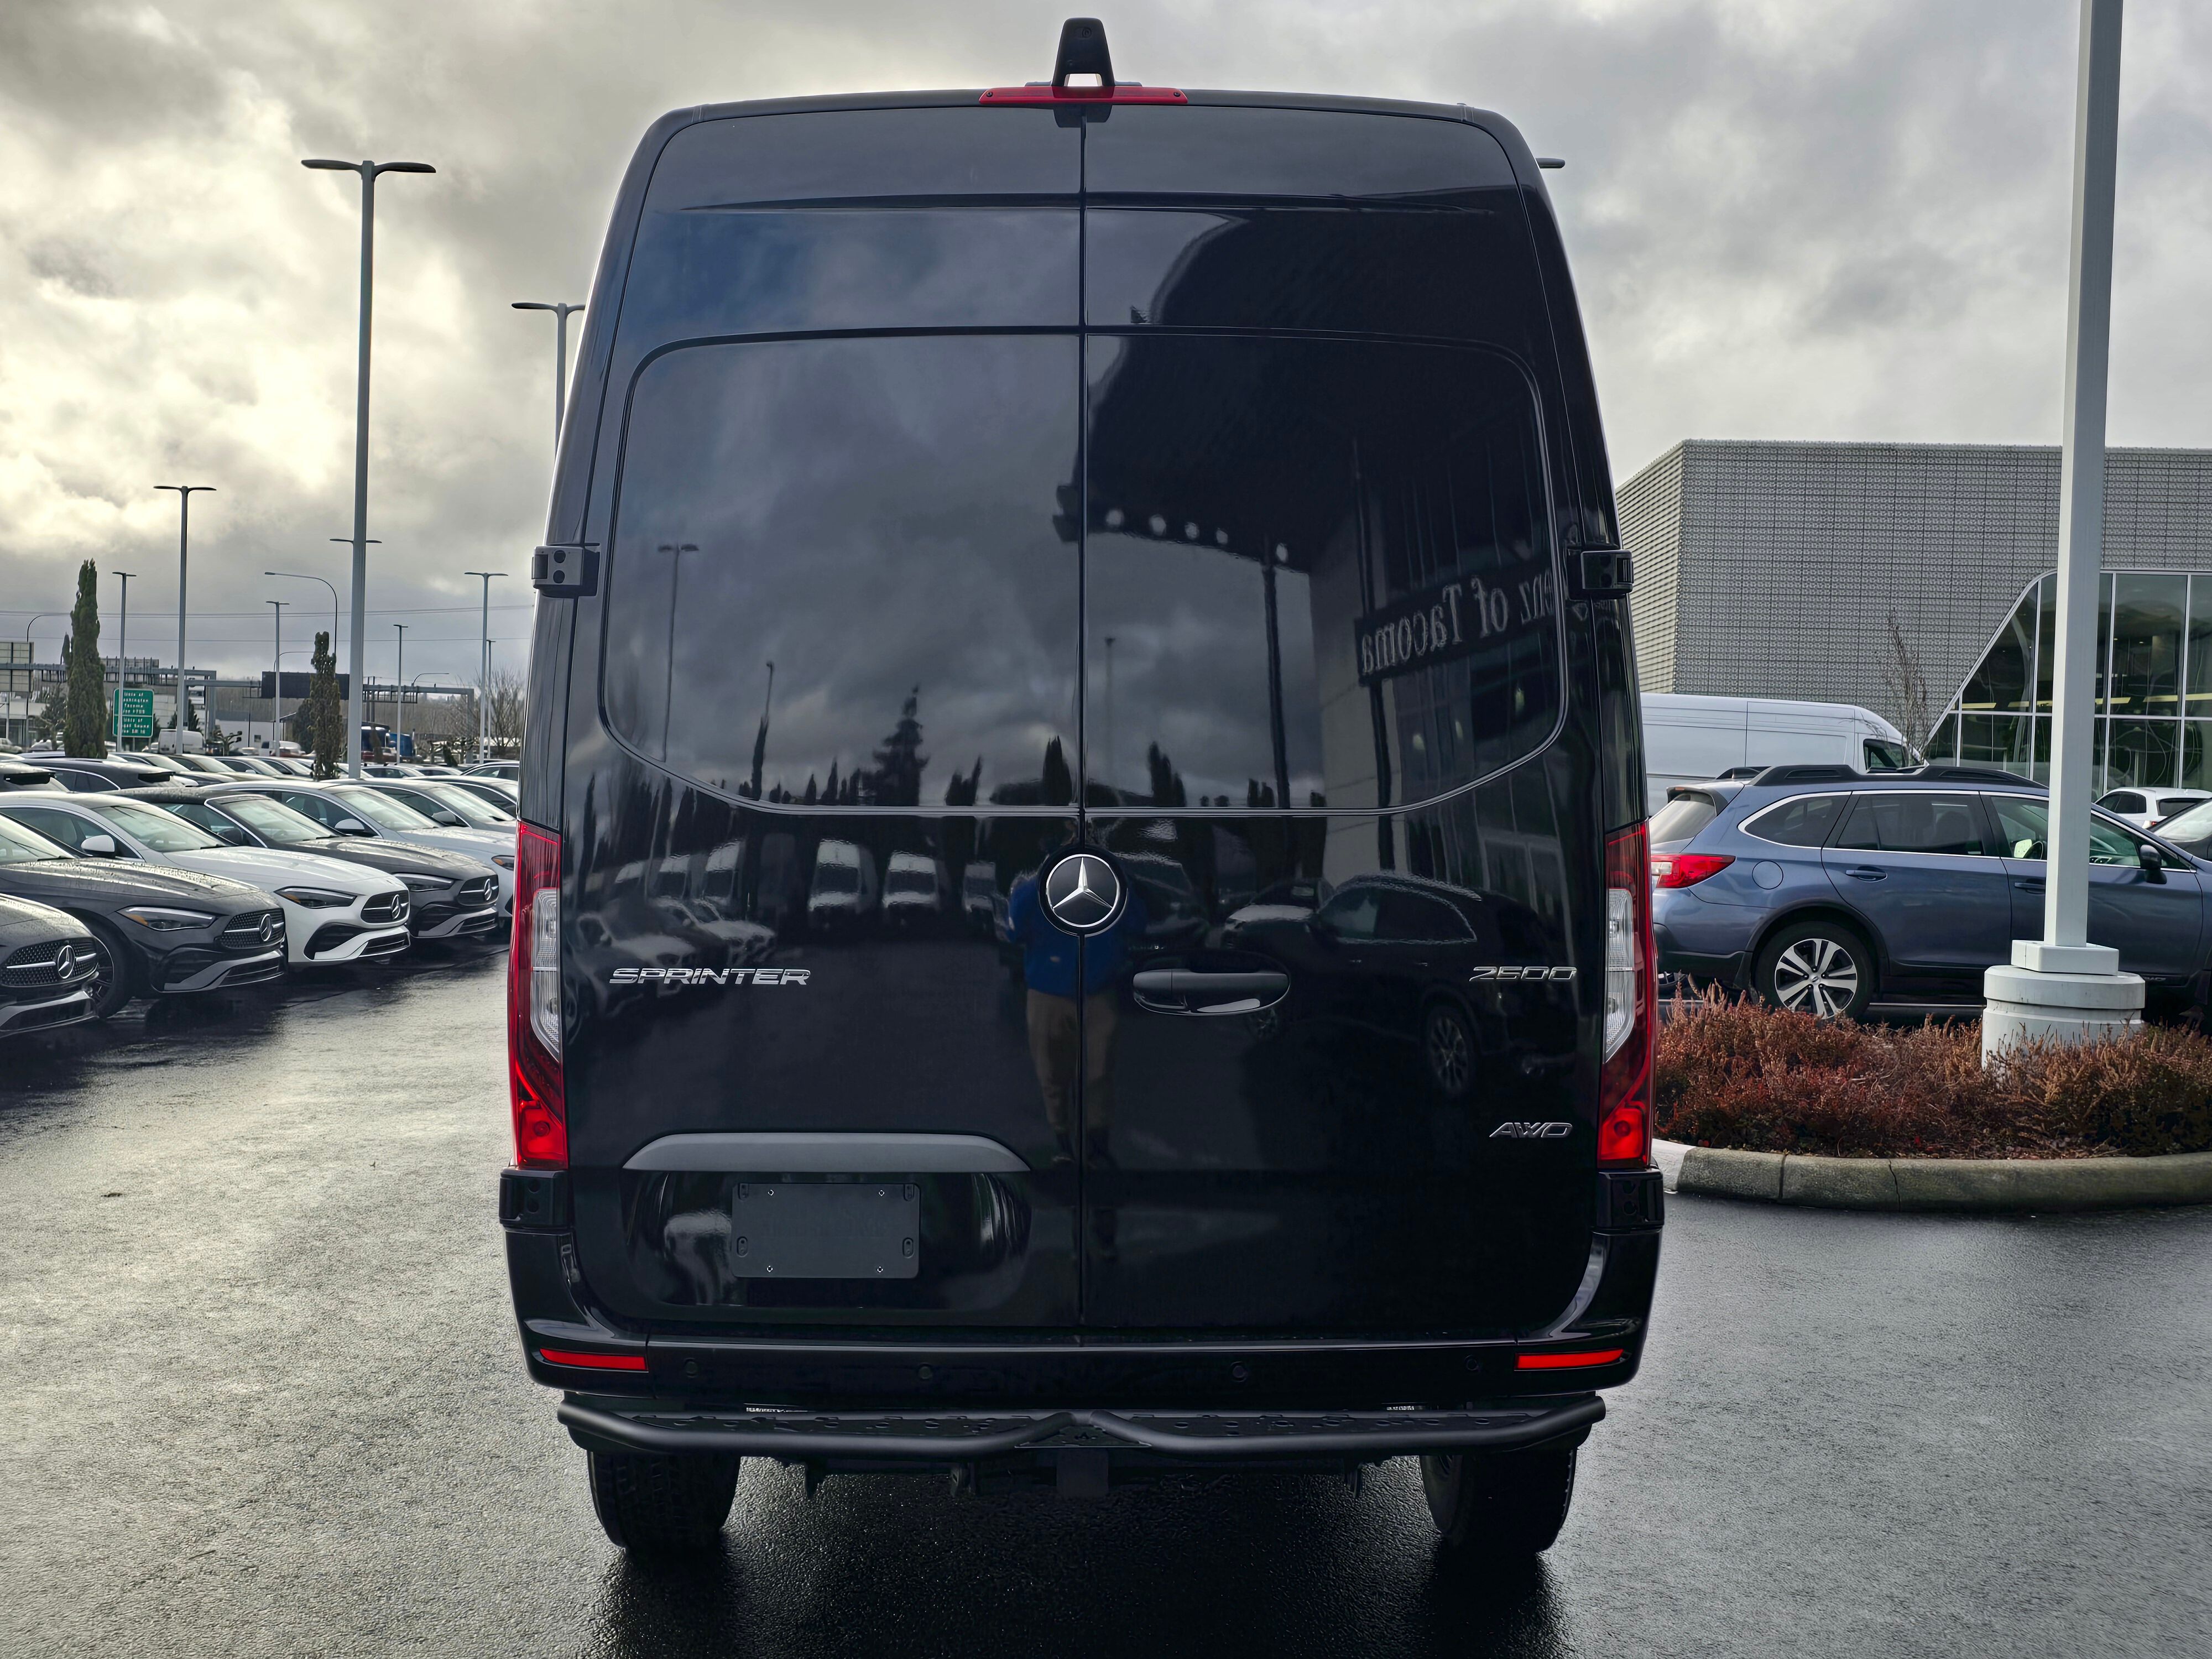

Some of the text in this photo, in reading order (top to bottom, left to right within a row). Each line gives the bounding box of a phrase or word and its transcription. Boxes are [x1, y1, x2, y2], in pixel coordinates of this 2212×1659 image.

[609, 968, 811, 985] SPRINTER
[1469, 966, 1577, 982] 2500
[1489, 1122, 1573, 1138] AWD
